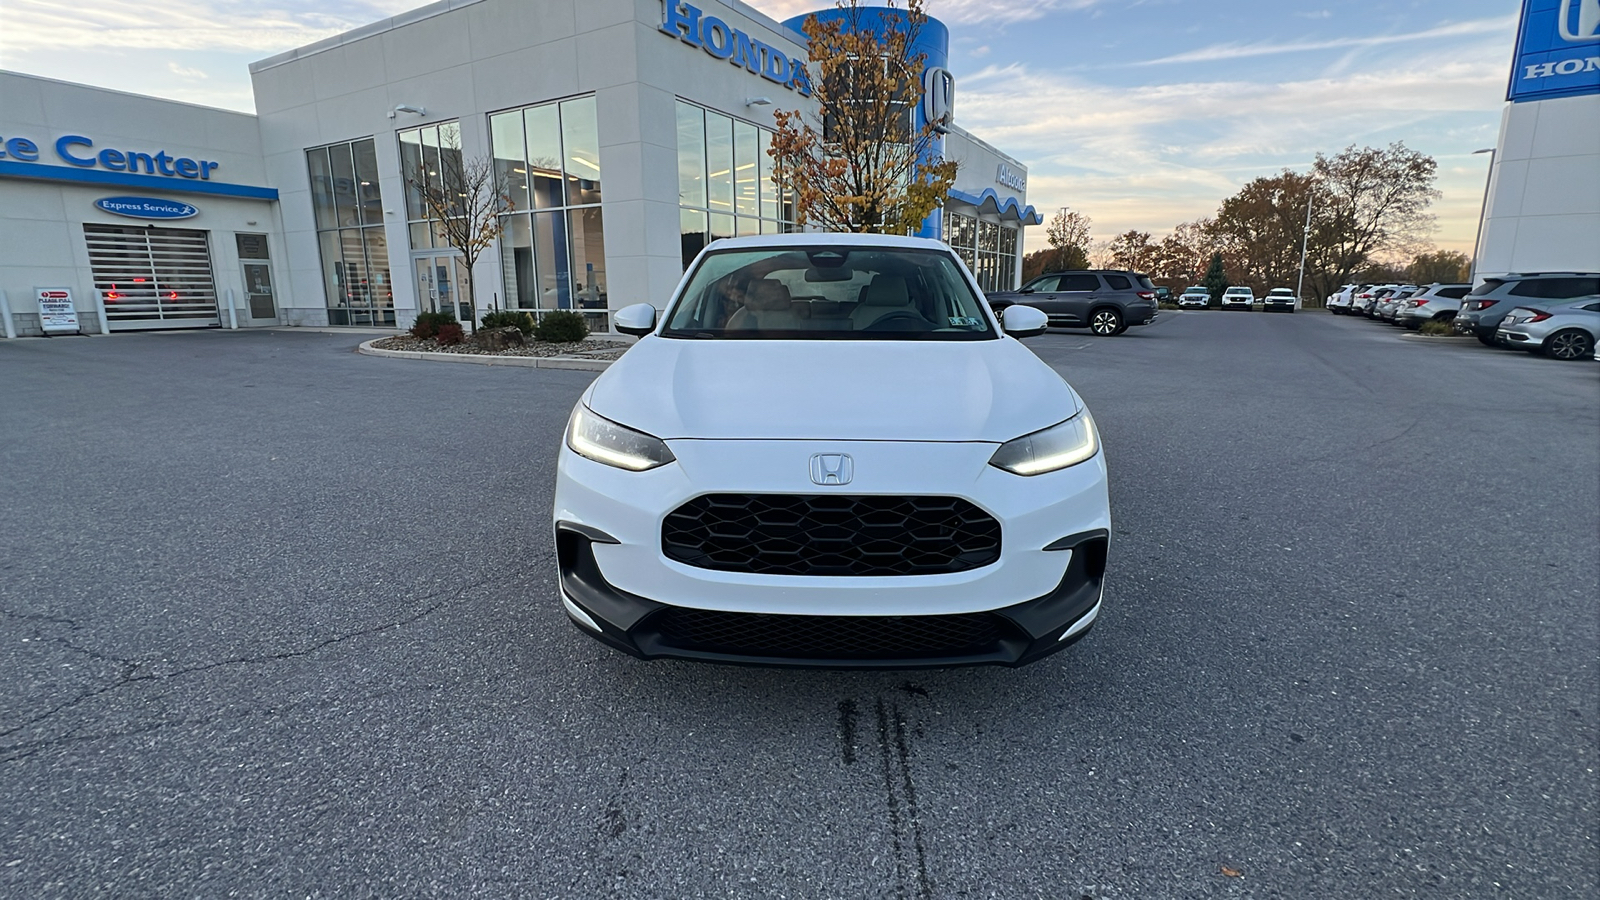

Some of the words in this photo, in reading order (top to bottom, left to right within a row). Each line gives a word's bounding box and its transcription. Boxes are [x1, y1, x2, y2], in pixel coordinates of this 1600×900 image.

[658, 0, 811, 97] HONDA
[55, 135, 219, 179] Center
[102, 200, 142, 211] Express
[143, 203, 179, 213] Service
